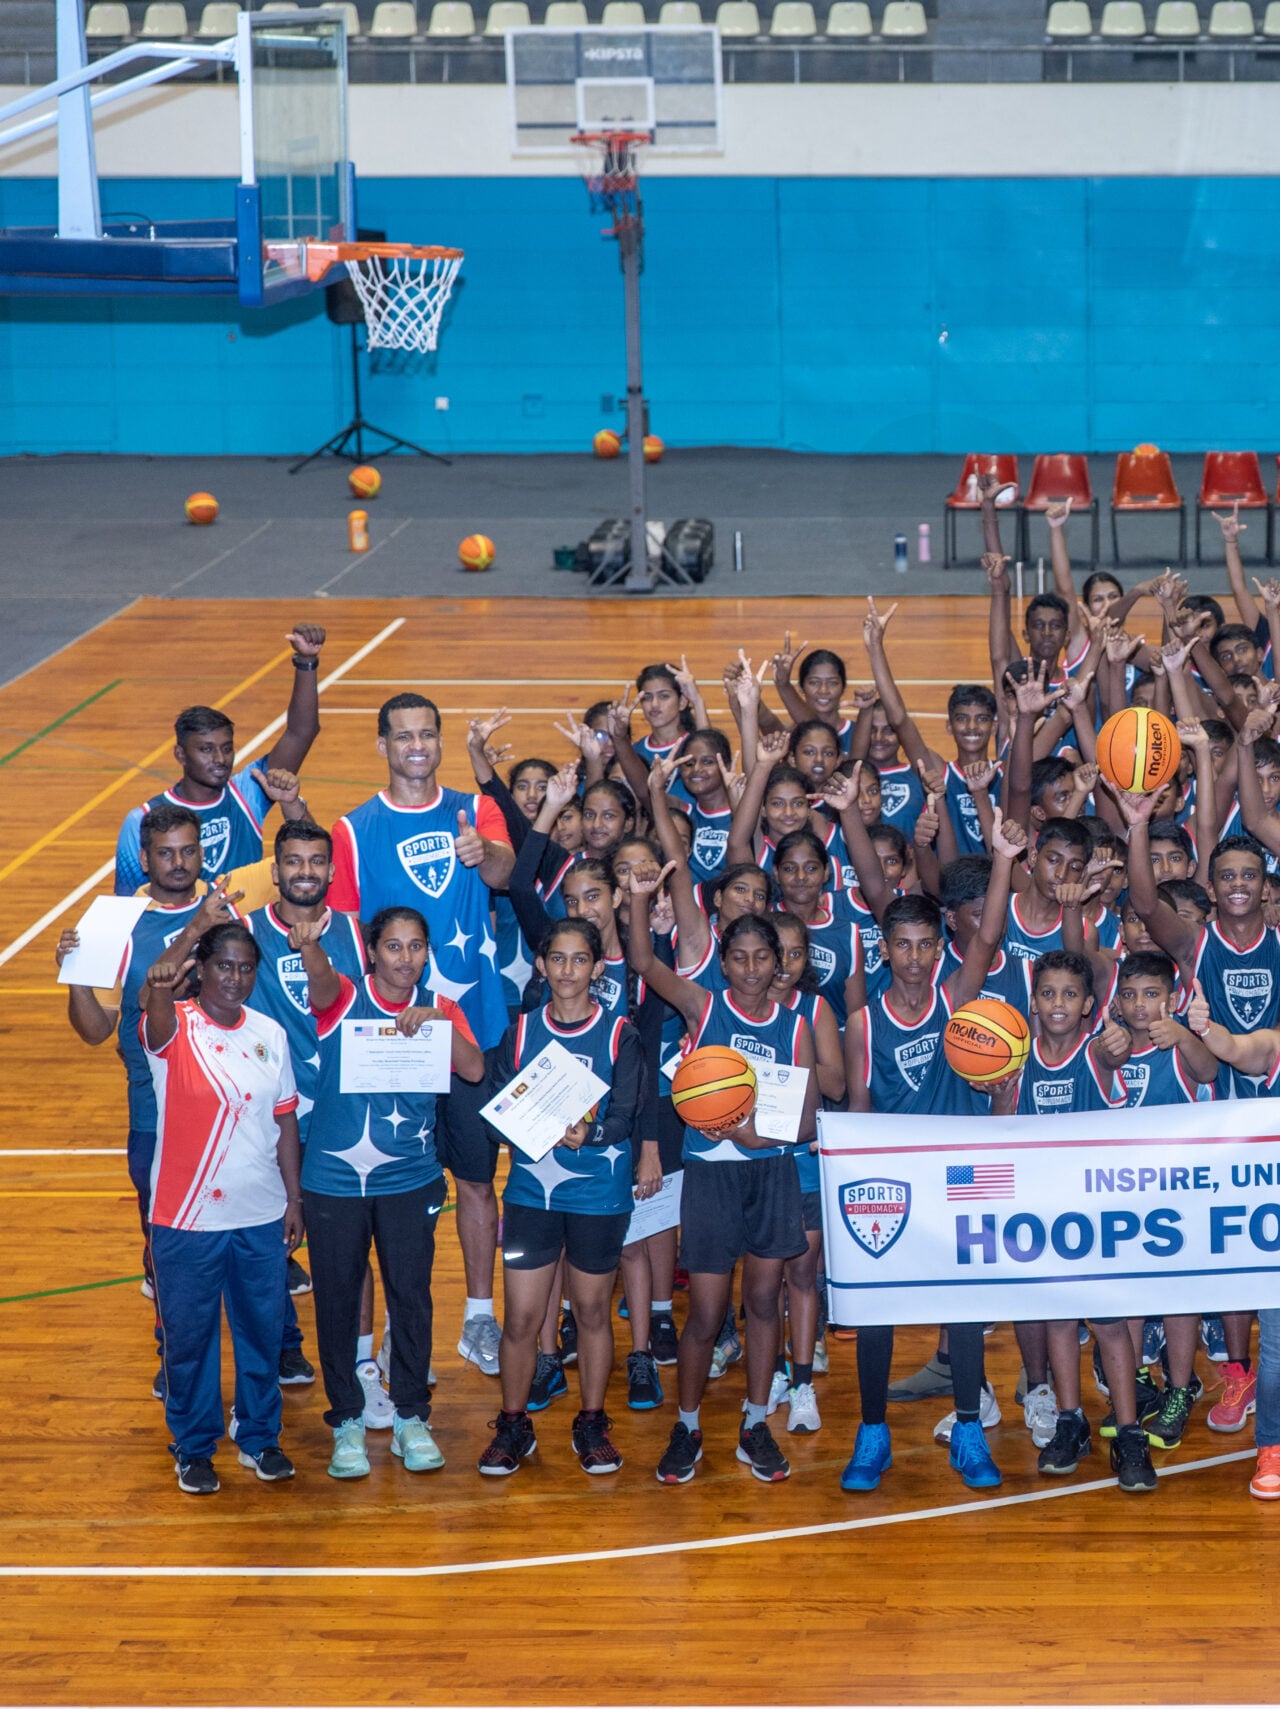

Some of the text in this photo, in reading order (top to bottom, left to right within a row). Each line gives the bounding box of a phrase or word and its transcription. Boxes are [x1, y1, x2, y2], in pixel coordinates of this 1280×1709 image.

[1148, 723, 1163, 776] molten
[200, 820, 229, 839] PORTS
[404, 836, 450, 857] SPORTS
[1229, 974, 1268, 987] SPORTS
[950, 1022, 996, 1048] molten
[1038, 1083, 1074, 1098] SPORTS
[1084, 1166, 1220, 1193] INSPIRE,
[848, 1186, 903, 1203] SPORTS
[854, 1204, 898, 1213] DIPLOMACY
[956, 1208, 1186, 1265] HOOPS
